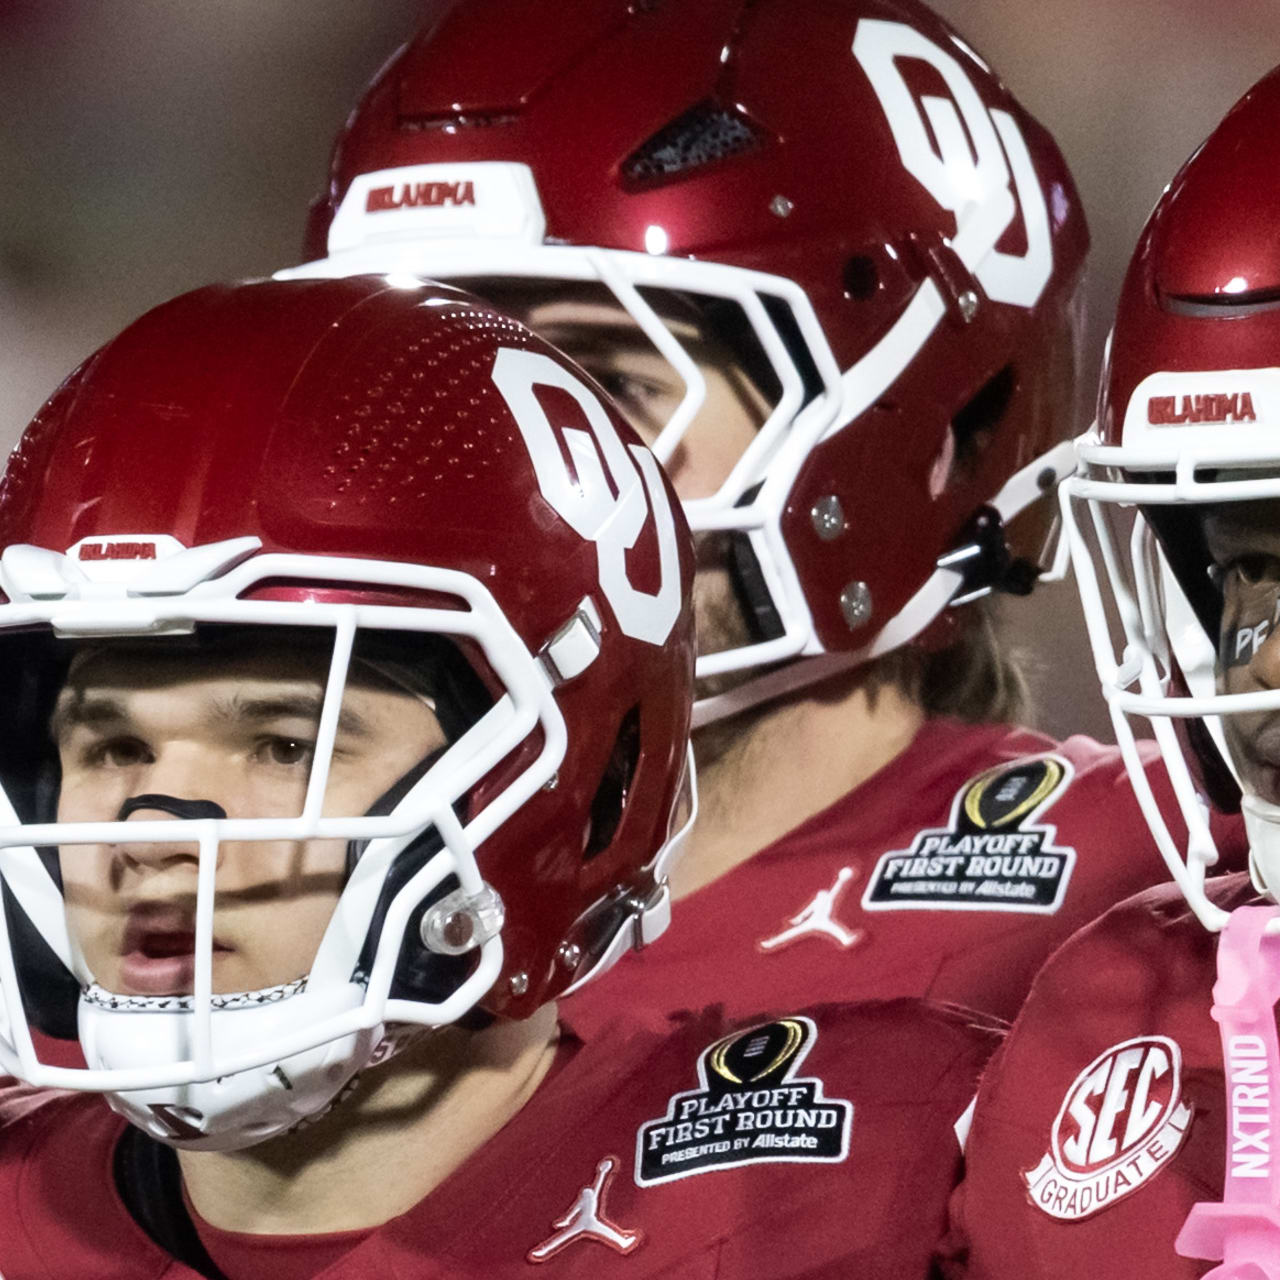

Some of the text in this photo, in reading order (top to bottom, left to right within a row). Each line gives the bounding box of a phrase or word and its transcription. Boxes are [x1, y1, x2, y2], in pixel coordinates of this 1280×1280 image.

[1148, 392, 1256, 424] OKLAHOMA
[491, 348, 683, 646] OU
[919, 834, 1039, 856] PLAYOFF
[884, 856, 1060, 879] FIRST ROUND
[975, 881, 1036, 898] Allstate
[679, 1087, 808, 1120] PLAYOFF
[1063, 1047, 1169, 1167] SEC
[1230, 1035, 1270, 1178] NXTRND
[648, 1109, 837, 1151] FIRST ROUND
[661, 1133, 818, 1165] PRESENTED BY Allstate
[1041, 1140, 1168, 1215] GRADUATE
